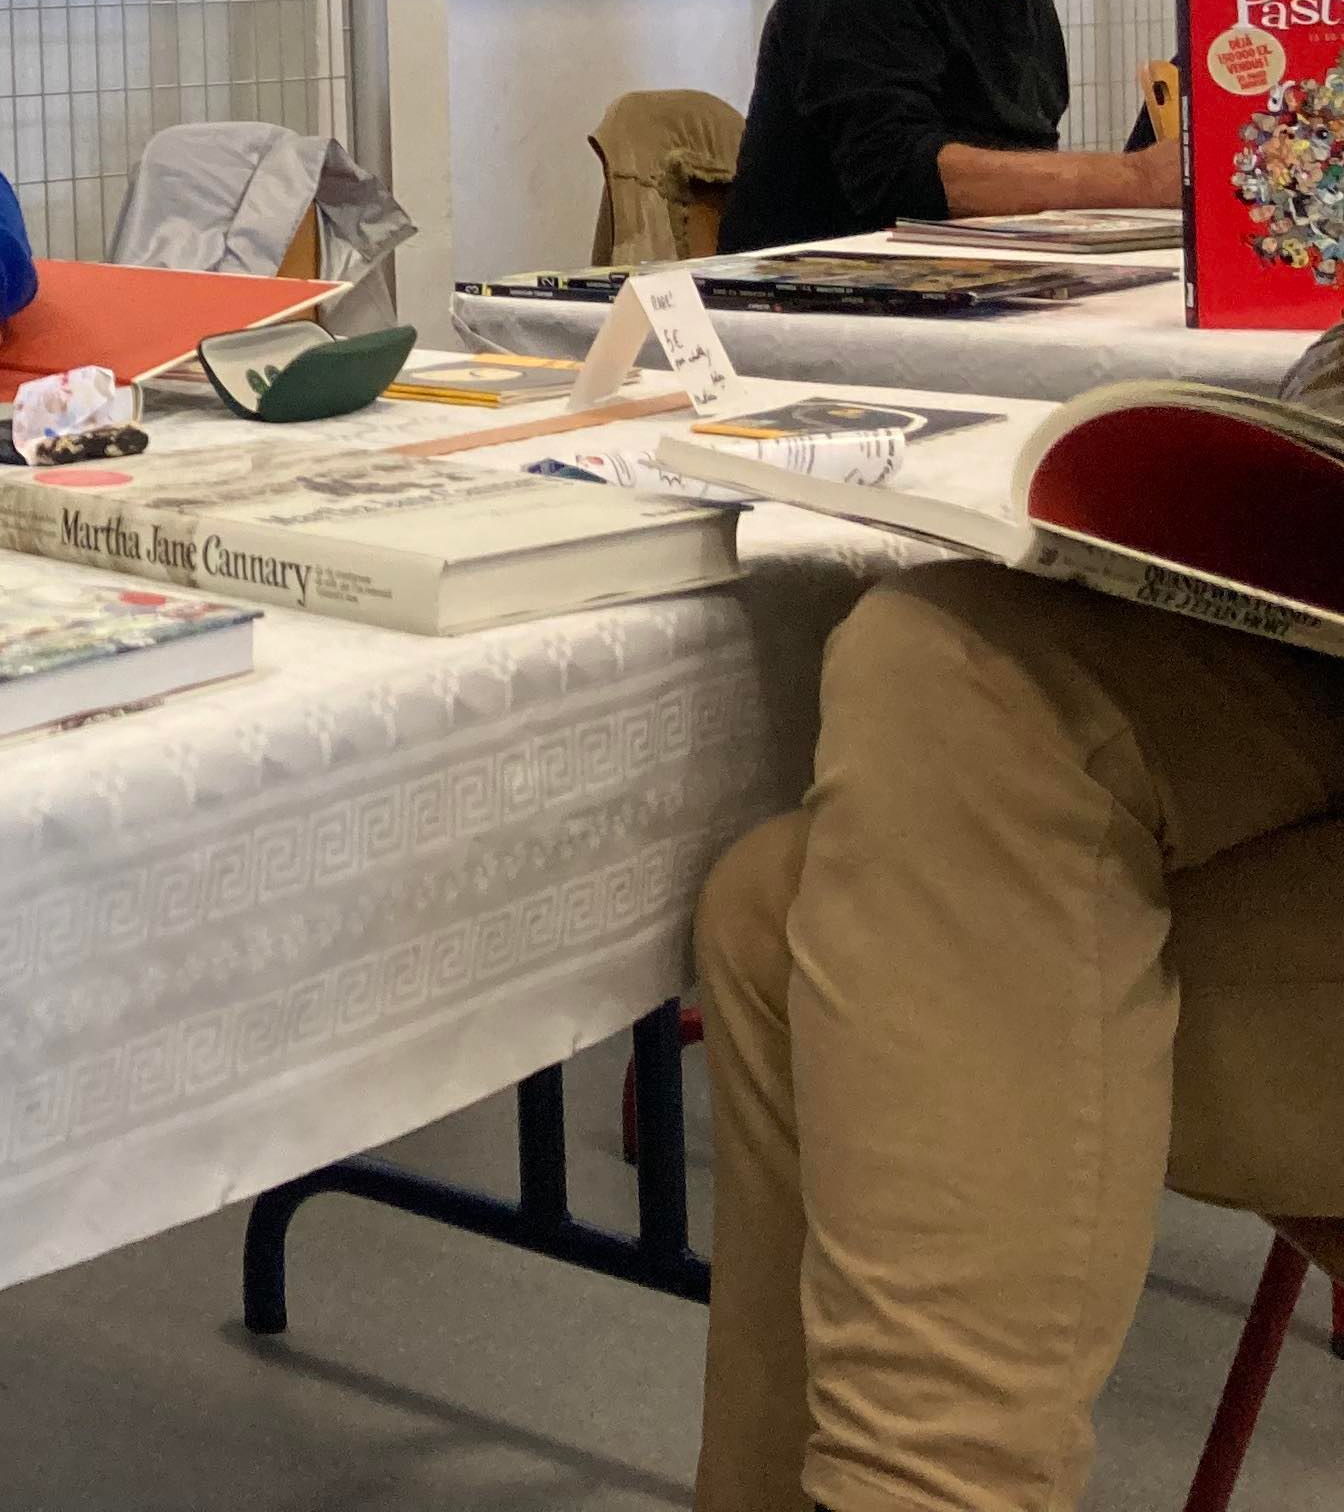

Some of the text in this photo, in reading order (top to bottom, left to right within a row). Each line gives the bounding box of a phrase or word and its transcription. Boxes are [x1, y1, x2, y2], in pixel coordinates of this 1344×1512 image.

[60, 506, 142, 561] Martha
[146, 523, 197, 571] Jane
[201, 534, 313, 607] Cannary
